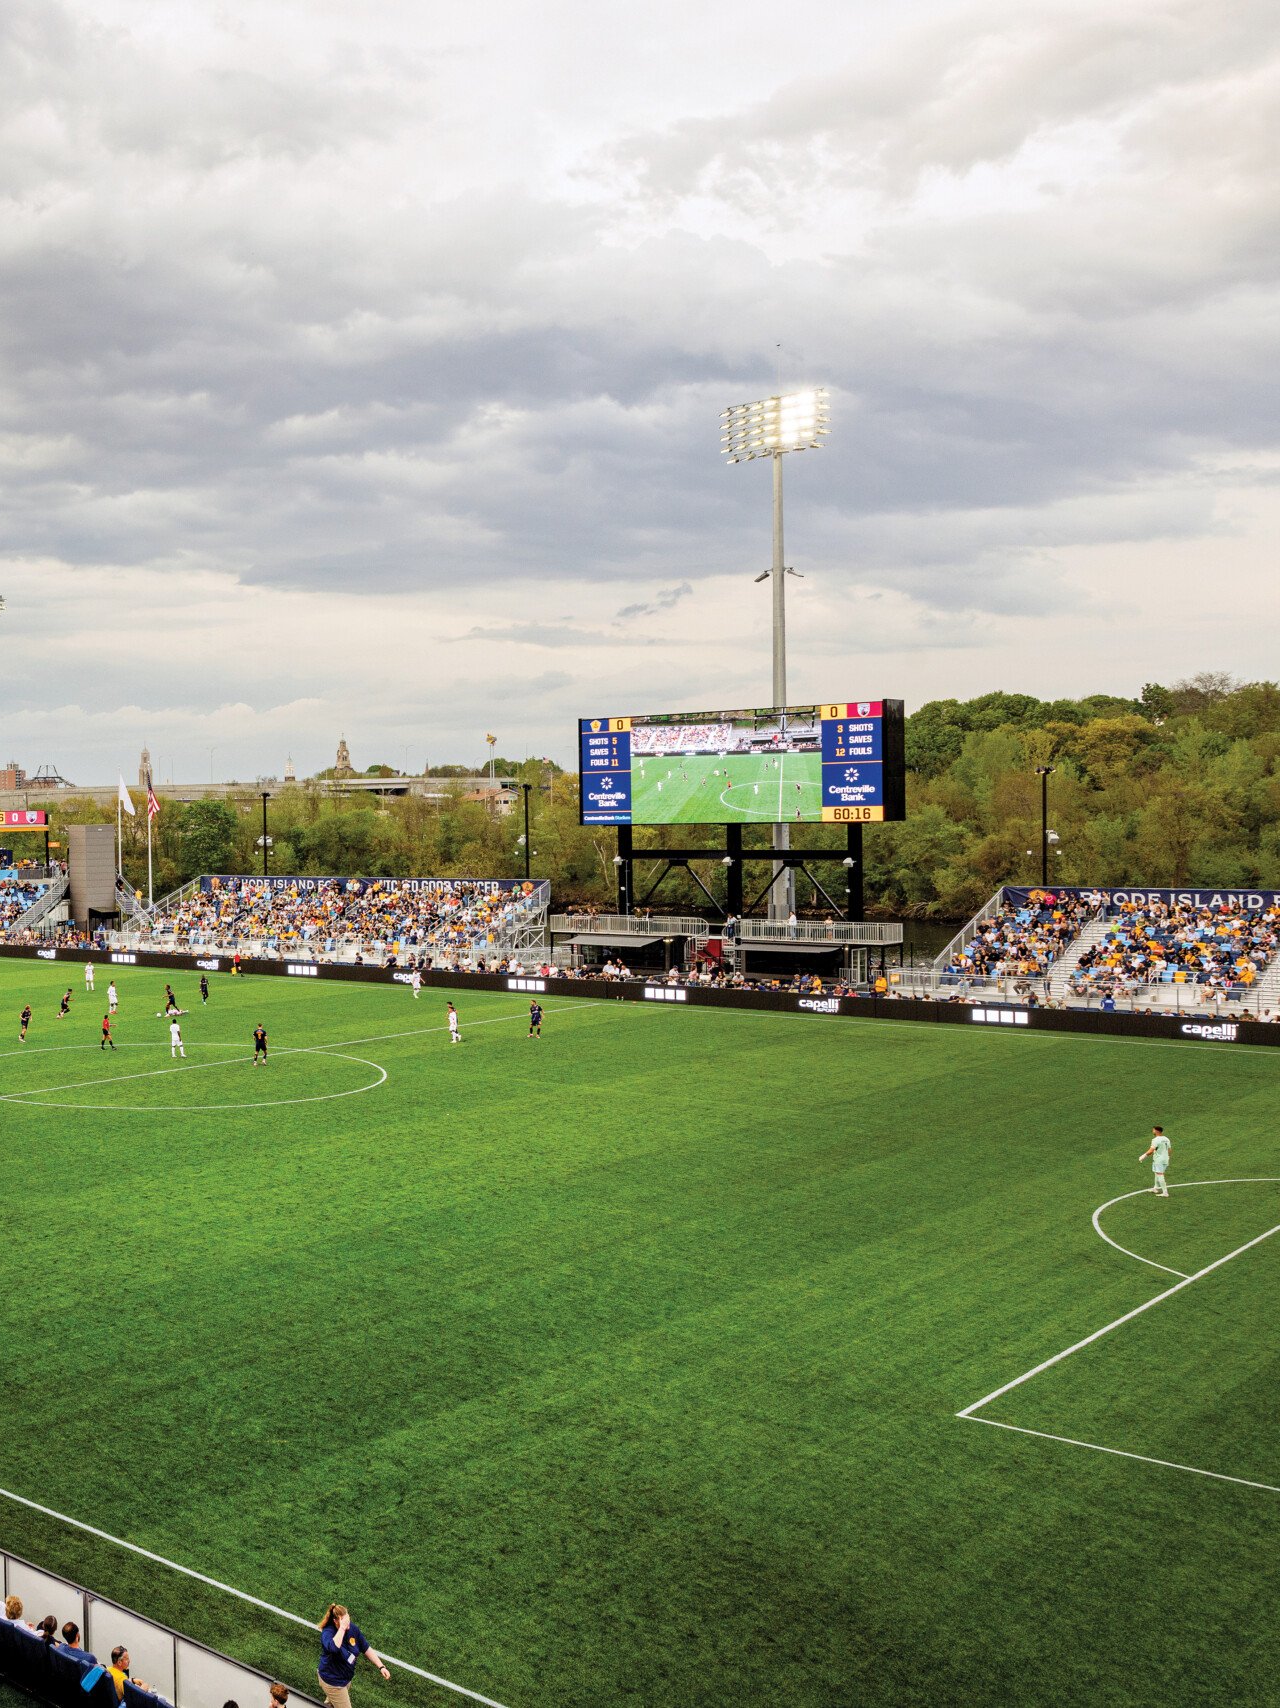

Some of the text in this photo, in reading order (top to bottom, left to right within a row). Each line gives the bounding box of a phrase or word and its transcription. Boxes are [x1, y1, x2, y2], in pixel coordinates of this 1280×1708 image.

[830, 706, 838, 718] 0
[616, 720, 624, 731] 0
[837, 723, 874, 733] 3 SHOTS
[589, 737, 618, 746] SHOTS 5
[837, 735, 873, 745] 1 SAVES
[590, 747, 617, 756] SAVES 1
[835, 747, 873, 757] 12 FOULS
[590, 758, 619, 767] FOULS 11
[828, 784, 875, 794] Centreville
[588, 792, 626, 800] Centreville
[12, 812, 18, 822] 0
[833, 807, 871, 820] 60:16
[274, 879, 314, 890] ISLAND
[1079, 892, 1161, 907] RODE
[1170, 893, 1264, 909] ISLAND
[798, 999, 839, 1010] capelli
[1181, 1023, 1237, 1037] capelli
